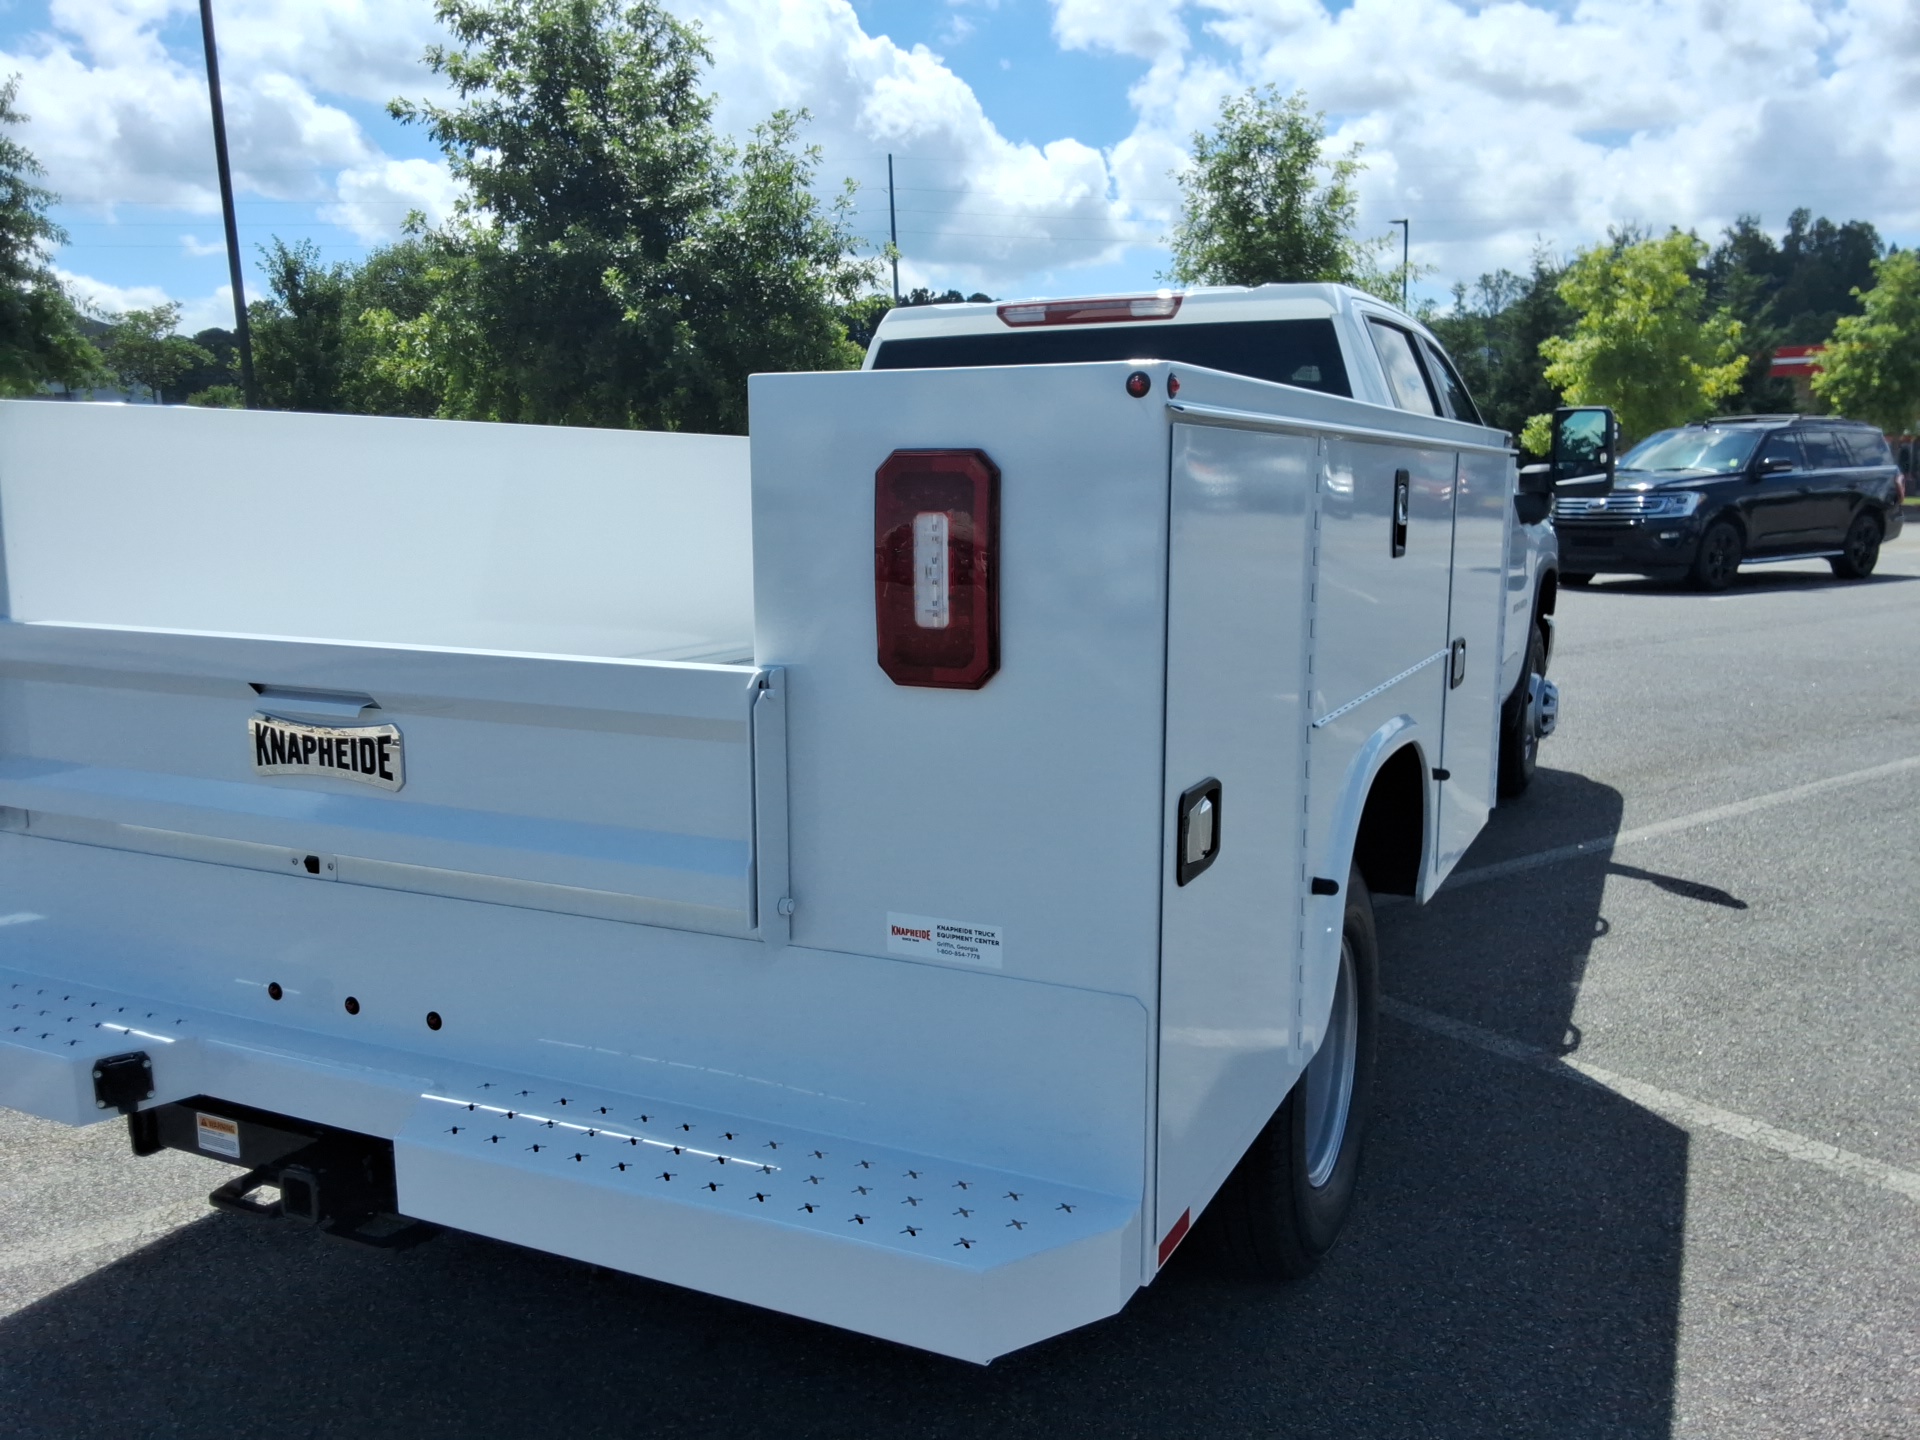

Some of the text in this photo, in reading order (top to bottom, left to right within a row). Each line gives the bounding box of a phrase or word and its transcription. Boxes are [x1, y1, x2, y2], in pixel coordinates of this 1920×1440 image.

[255, 722, 394, 781] KNAPHEIDE
[891, 925, 931, 941] KNAPHEIDE
[936, 925, 996, 938] KNAPHEIDE TRUCK
[936, 932, 1000, 946] EQUIPMENT CENTER
[936, 941, 979, 953] Griffin, Georgia
